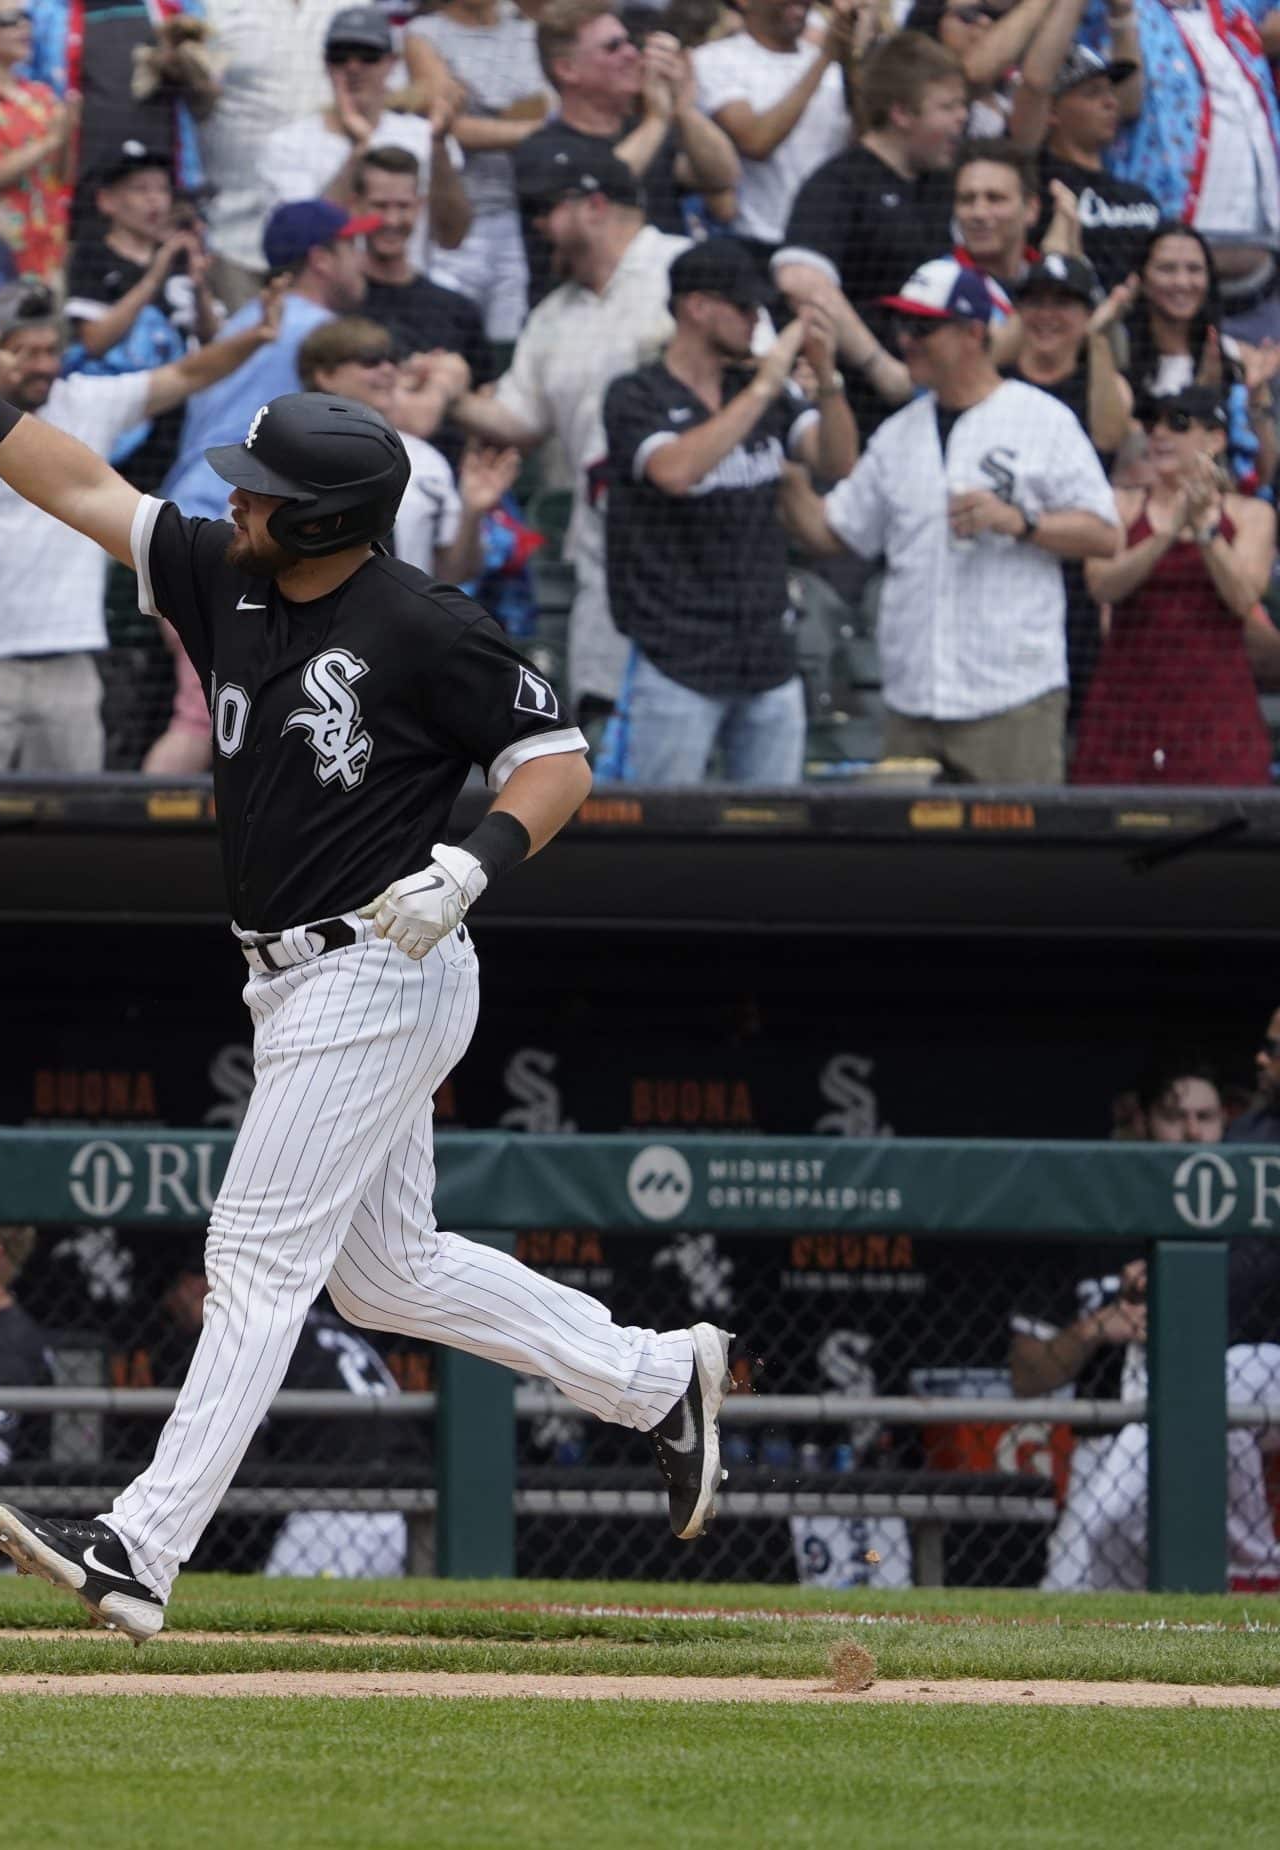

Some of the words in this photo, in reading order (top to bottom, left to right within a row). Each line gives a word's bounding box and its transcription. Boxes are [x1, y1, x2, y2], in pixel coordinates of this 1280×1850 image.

[280, 647, 373, 792] Sox
[33, 1070, 157, 1116] BUONA
[632, 1079, 753, 1123] BUONA
[707, 1160, 825, 1182] MIDWEST
[707, 1187, 903, 1211] ORTHOPAEDICS
